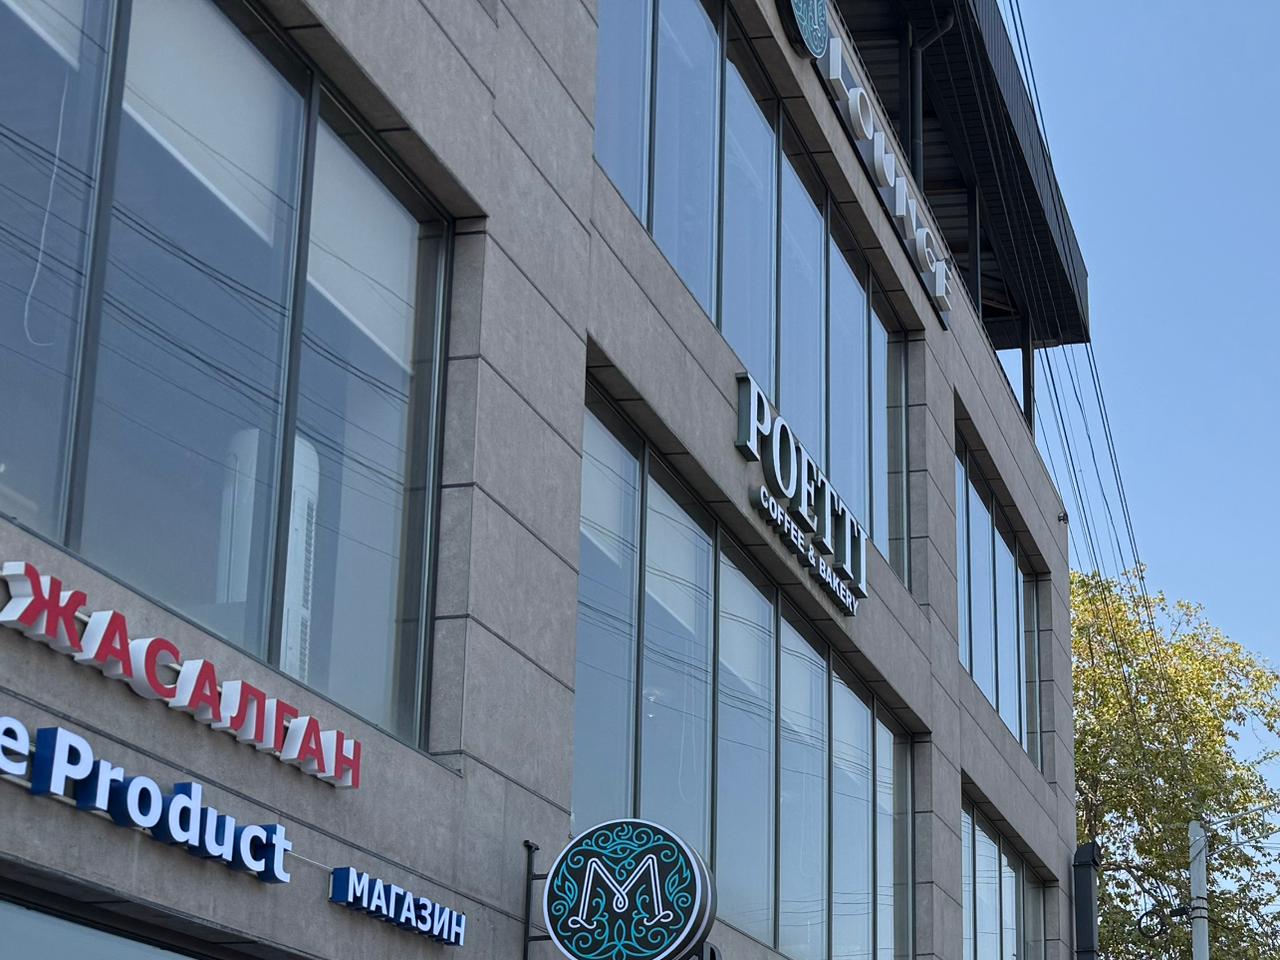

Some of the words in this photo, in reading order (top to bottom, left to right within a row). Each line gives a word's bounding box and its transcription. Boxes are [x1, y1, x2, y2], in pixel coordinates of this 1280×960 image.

[830, 38, 951, 312] LOUNGE
[737, 373, 868, 598] POETTI
[757, 485, 805, 554] COFFEE
[806, 544, 816, 566] &
[818, 556, 860, 618] BAKERY
[2, 561, 362, 789] ЖАСАЛГАН
[34, 726, 292, 884] Product
[334, 866, 467, 947] МАГАЗИН
